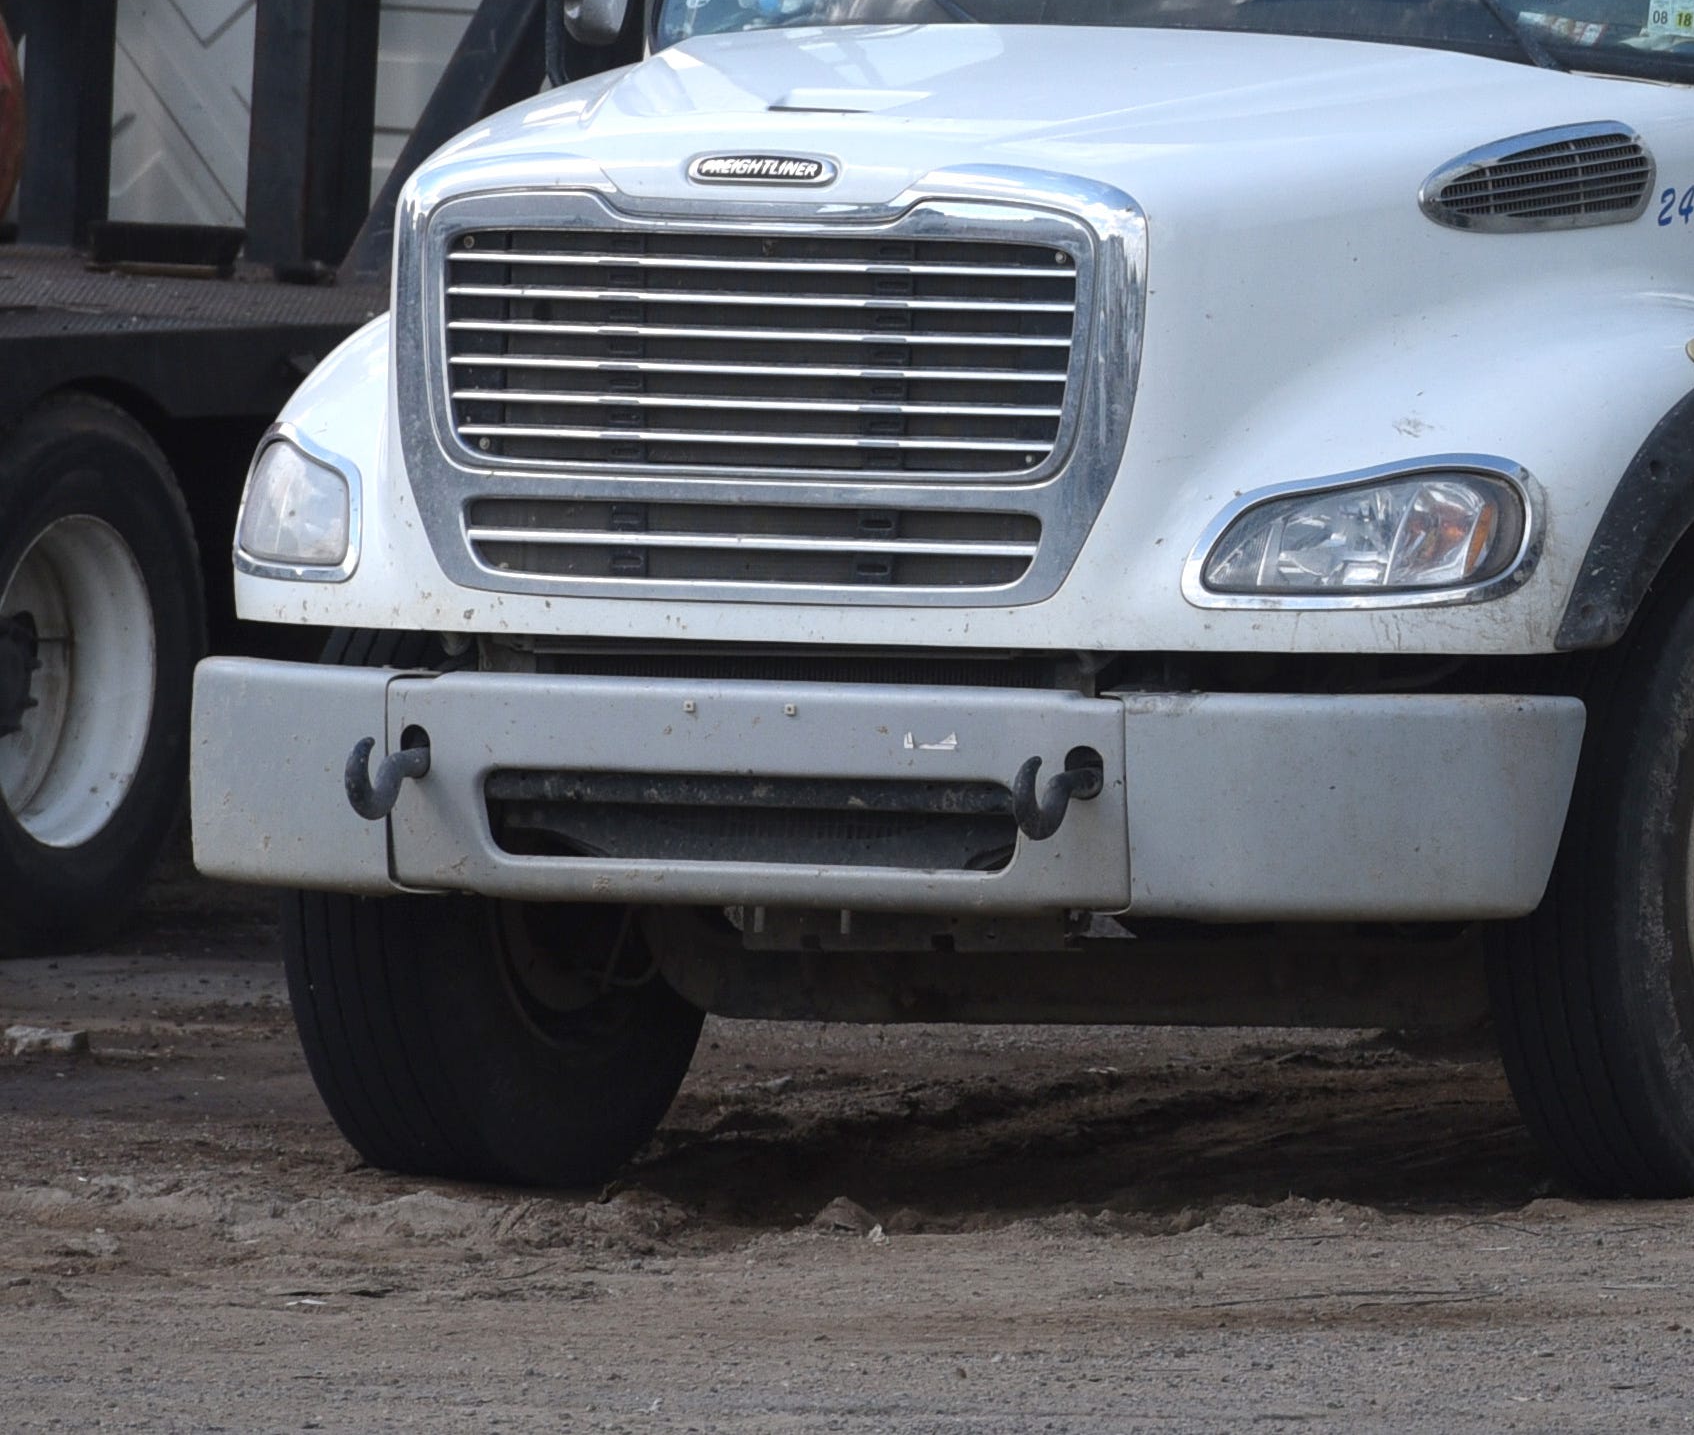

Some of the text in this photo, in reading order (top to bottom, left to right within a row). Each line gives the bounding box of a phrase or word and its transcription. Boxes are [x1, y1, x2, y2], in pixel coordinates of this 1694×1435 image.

[1653, 10, 1668, 24] 08
[1677, 12, 1693, 27] 18
[701, 158, 818, 177] FREIGHTLINER
